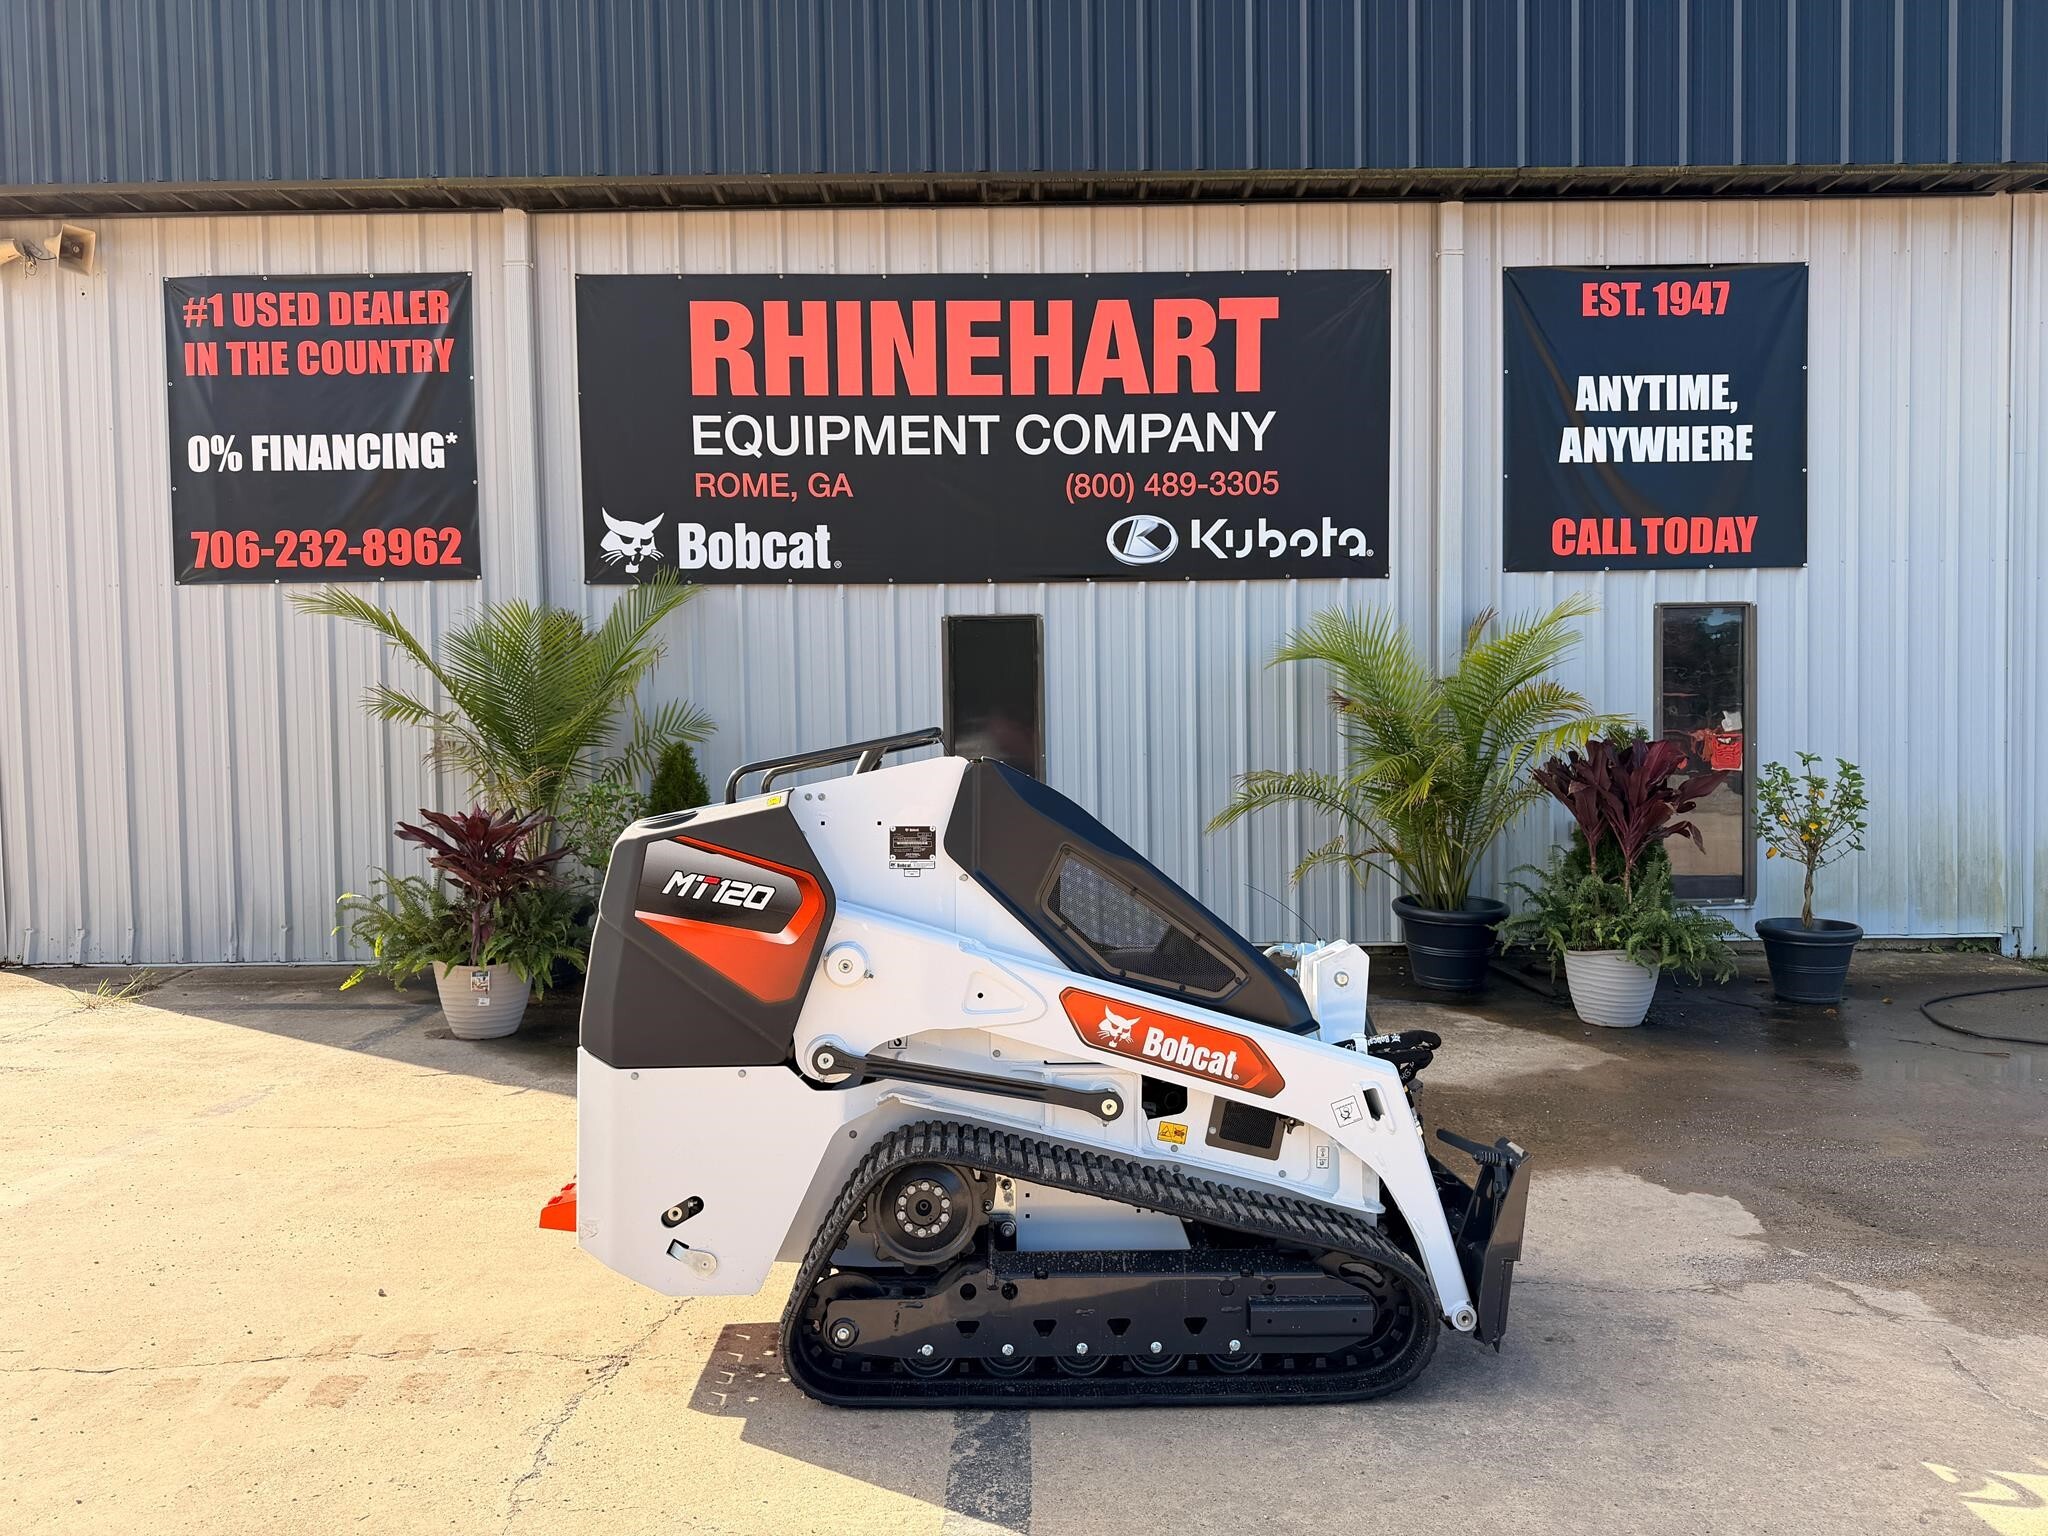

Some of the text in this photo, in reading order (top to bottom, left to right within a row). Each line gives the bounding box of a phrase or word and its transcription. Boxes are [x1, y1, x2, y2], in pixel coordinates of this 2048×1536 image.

[183, 290, 450, 328] #1 USED DEALER
[1582, 281, 1731, 317] EST. 1947
[184, 338, 455, 376] IN THE COUNTRY
[689, 296, 1280, 396] RHINEHART
[1575, 374, 1738, 414] ANYTIME,
[187, 434, 243, 472] 0%
[692, 411, 1277, 458] EQUIPMENT COMPANY
[1558, 425, 1753, 463] ANYWHERE
[695, 472, 854, 502] ROME, GA
[1066, 470, 1280, 504] (800) 489-3305
[190, 527, 462, 569] 706-232-8962
[678, 523, 832, 570] Bobcat
[1191, 516, 1367, 559] Kubota
[1552, 516, 1759, 556] CALL TODAY
[661, 870, 776, 911] MT120
[1142, 1026, 1238, 1080] Bobcat
